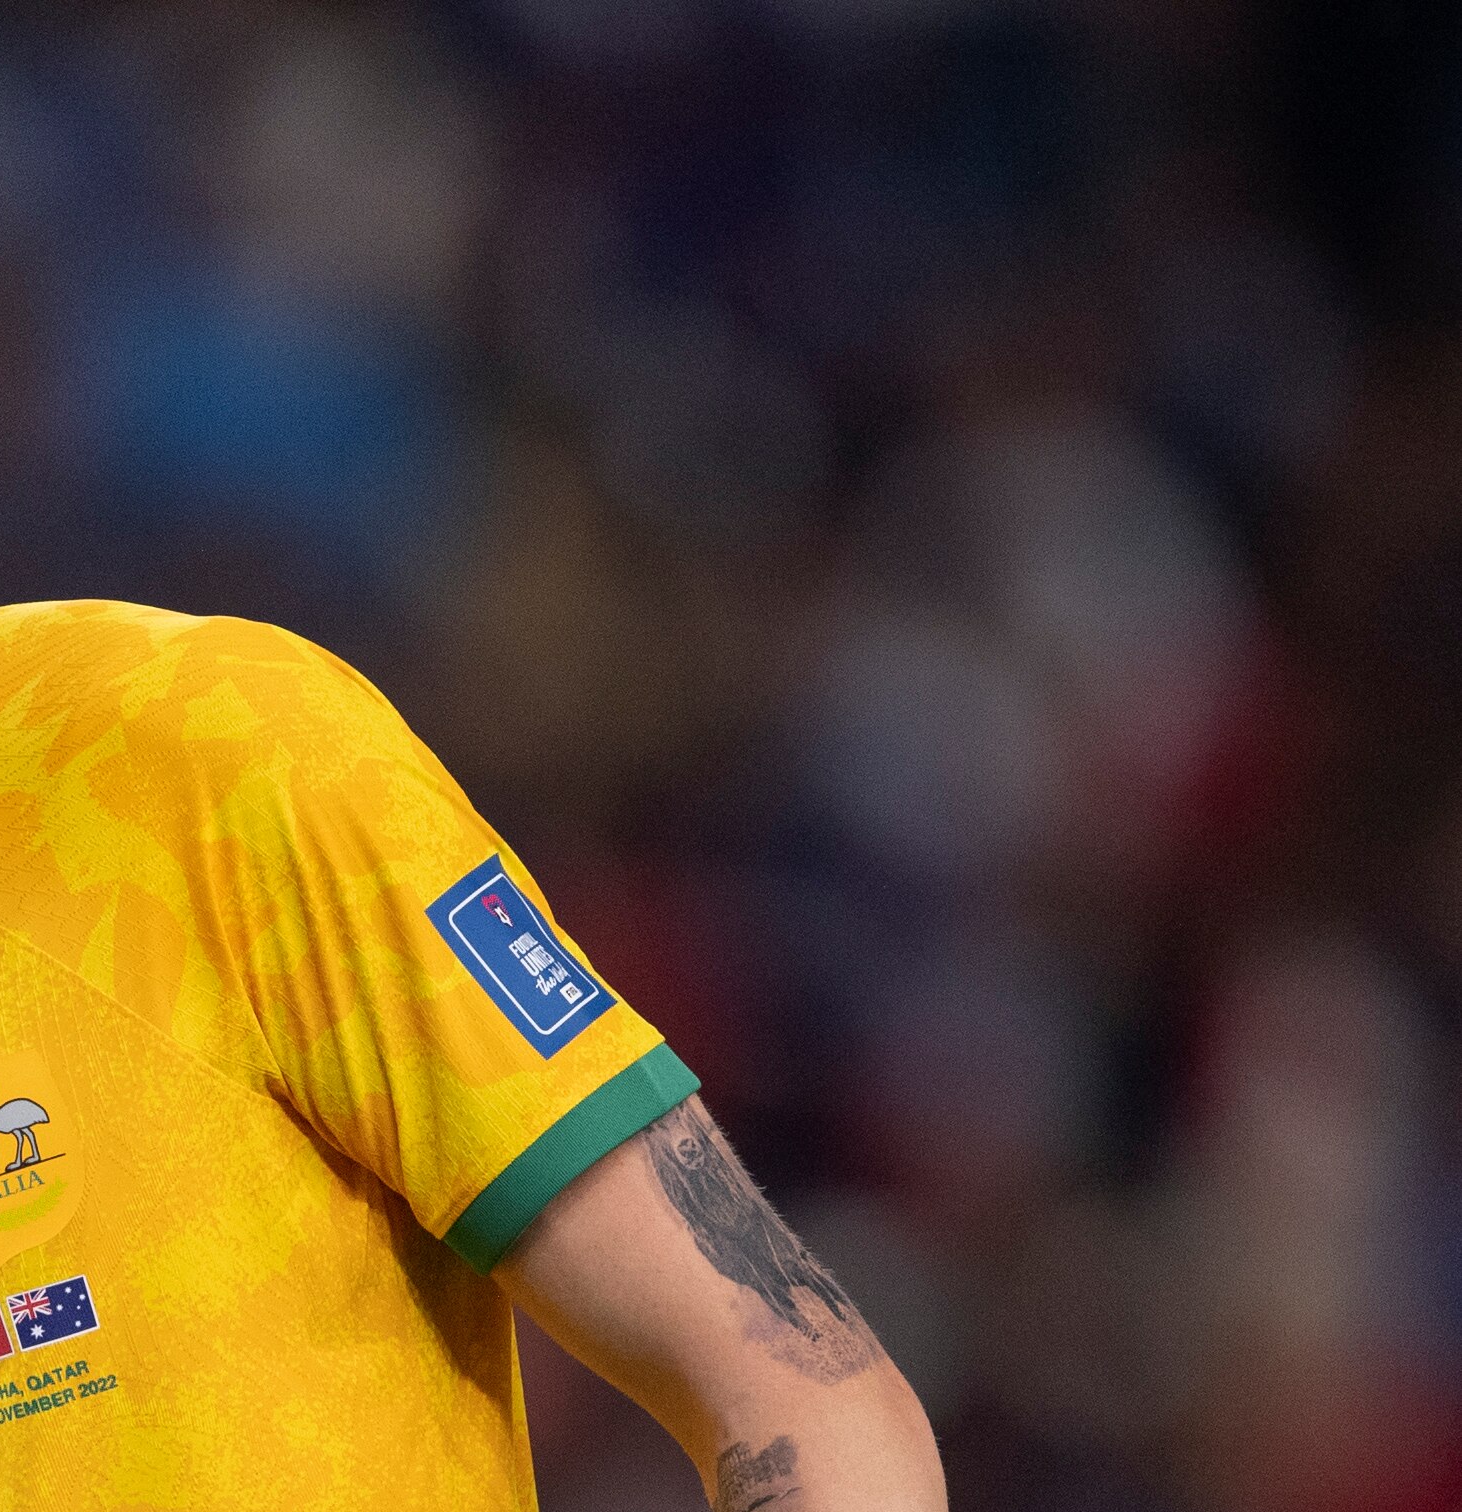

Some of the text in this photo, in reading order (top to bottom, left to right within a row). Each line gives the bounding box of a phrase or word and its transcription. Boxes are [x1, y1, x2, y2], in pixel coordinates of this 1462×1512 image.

[536, 975, 557, 996] the
[26, 1360, 89, 1391] QATAR
[78, 1374, 118, 1398] 2022
